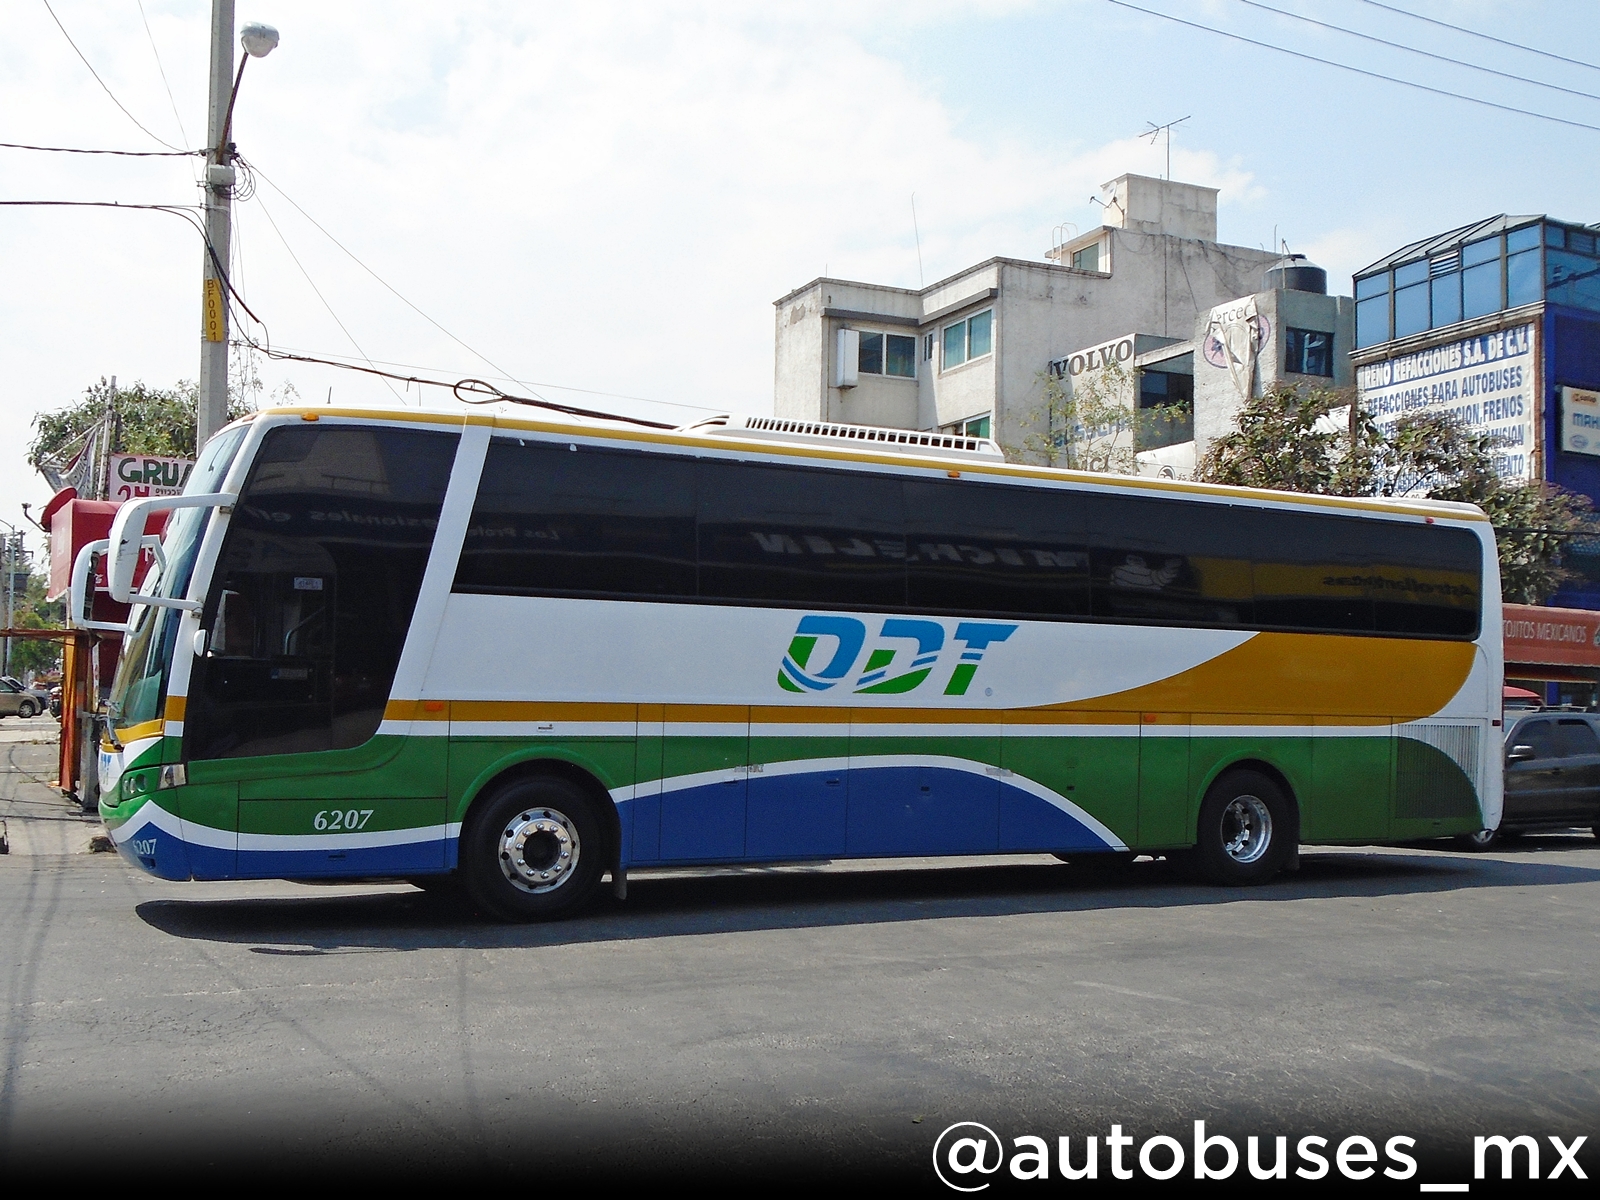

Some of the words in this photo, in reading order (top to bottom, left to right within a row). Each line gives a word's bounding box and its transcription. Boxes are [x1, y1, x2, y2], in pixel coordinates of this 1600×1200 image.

[1052, 339, 1133, 381] VOLVO
[1393, 342, 1461, 383] REFACCIONES
[1463, 338, 1485, 366] S.A.
[1488, 332, 1503, 360] DE
[1367, 385, 1429, 417] REFACCIONES
[1431, 379, 1458, 404] PARA
[1461, 365, 1522, 394] AUTOBUSES
[1483, 394, 1524, 423] FRENOS
[1536, 622, 1587, 643] MEXICANOS
[313, 809, 374, 831] 6207
